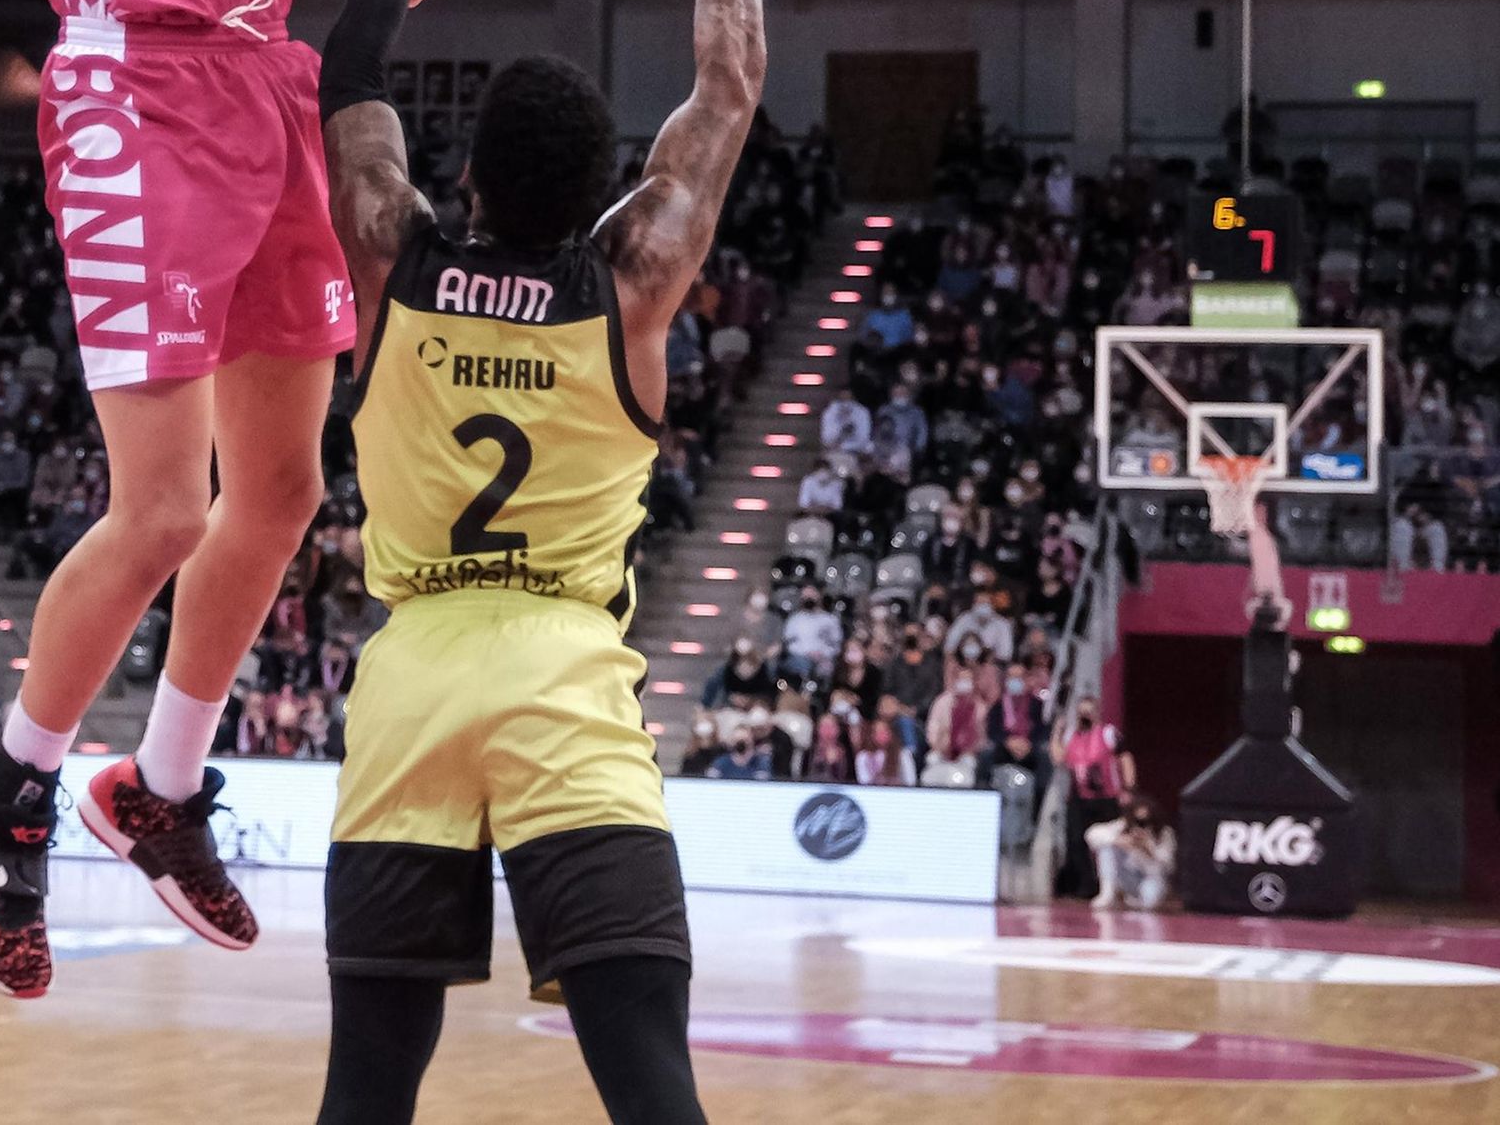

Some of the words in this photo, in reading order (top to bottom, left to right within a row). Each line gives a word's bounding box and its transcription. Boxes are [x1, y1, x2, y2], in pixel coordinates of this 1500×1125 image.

[49, 53, 148, 353] BONN
[1248, 230, 1276, 273] 7
[436, 268, 553, 322] ANIM
[452, 355, 555, 390] REHAU
[451, 413, 533, 555] 2
[1213, 816, 1320, 866] RKG
